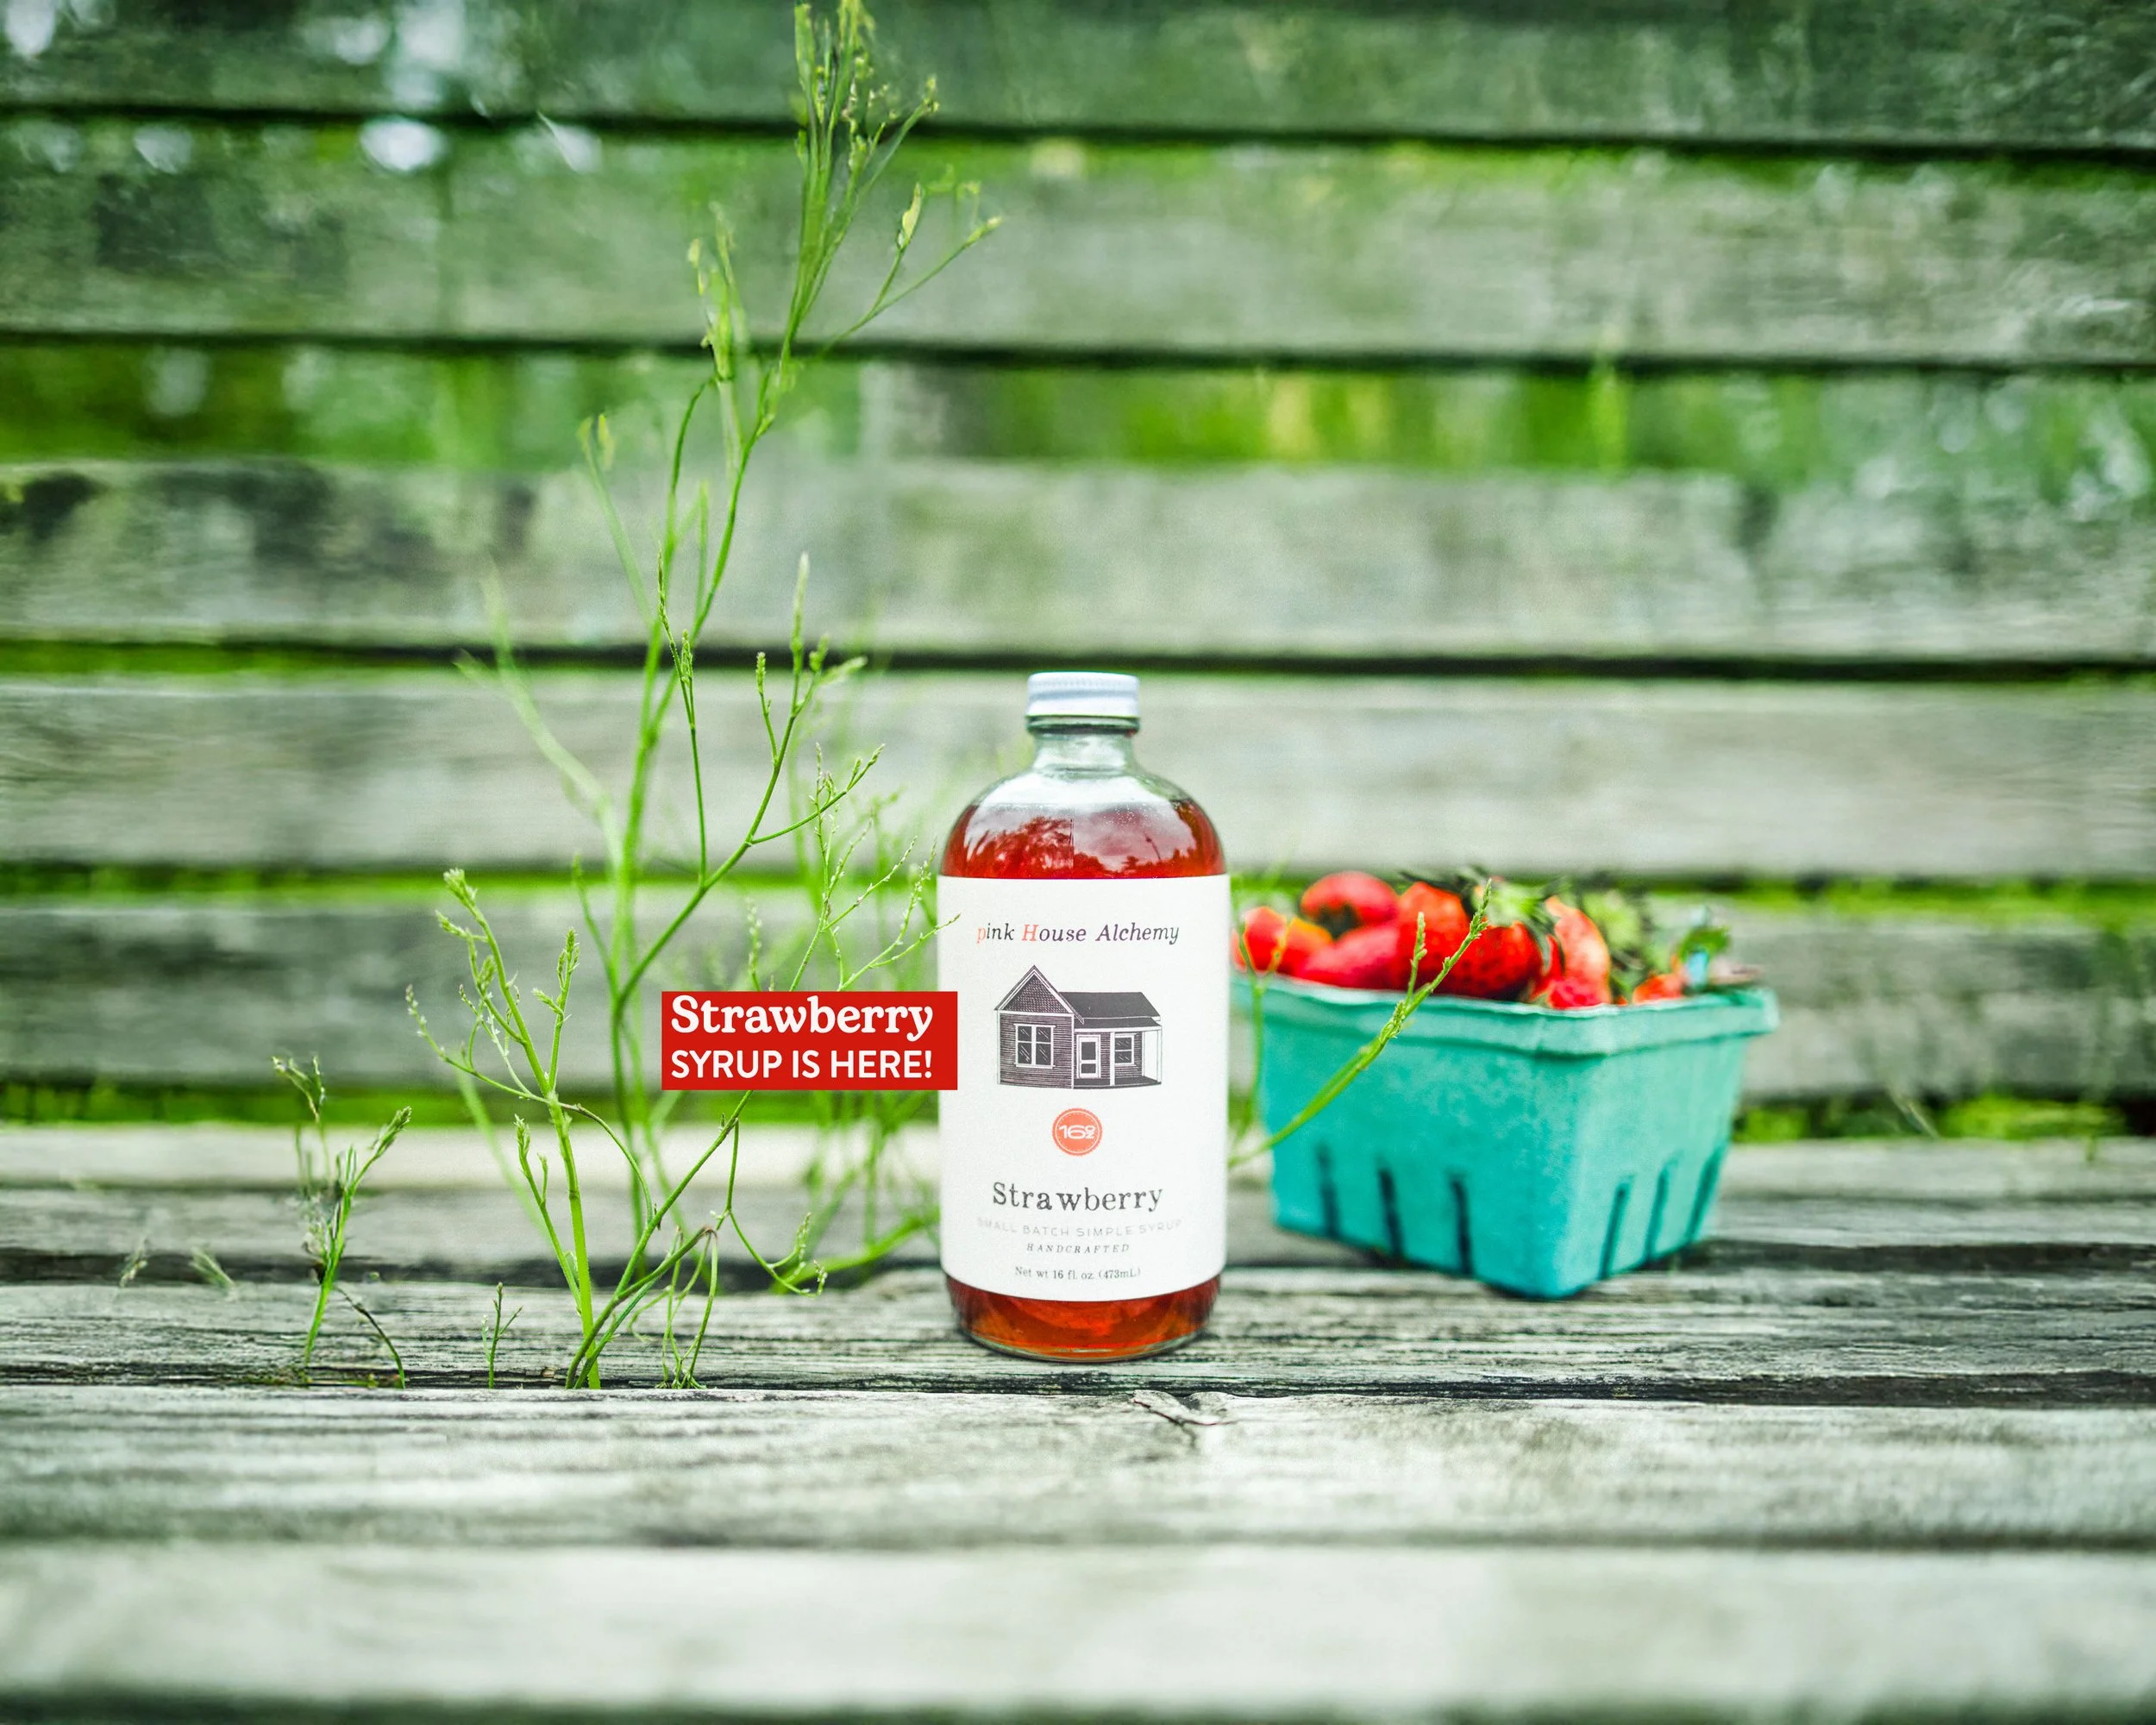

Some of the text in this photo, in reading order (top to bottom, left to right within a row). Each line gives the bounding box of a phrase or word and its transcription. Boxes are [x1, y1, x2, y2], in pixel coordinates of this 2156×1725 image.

[977, 923, 1179, 944] pink House Alchemy
[993, 1182, 1163, 1212] Strawberry
[1023, 1225, 1069, 1236] BATCH
[1076, 1226, 1133, 1237] SIMPLE
[1138, 1219, 1181, 1234] SYRUP
[1026, 1243, 1129, 1254] HANDCRAFTED
[1015, 1266, 1031, 1276] Net
[1053, 1270, 1063, 1279] 16
